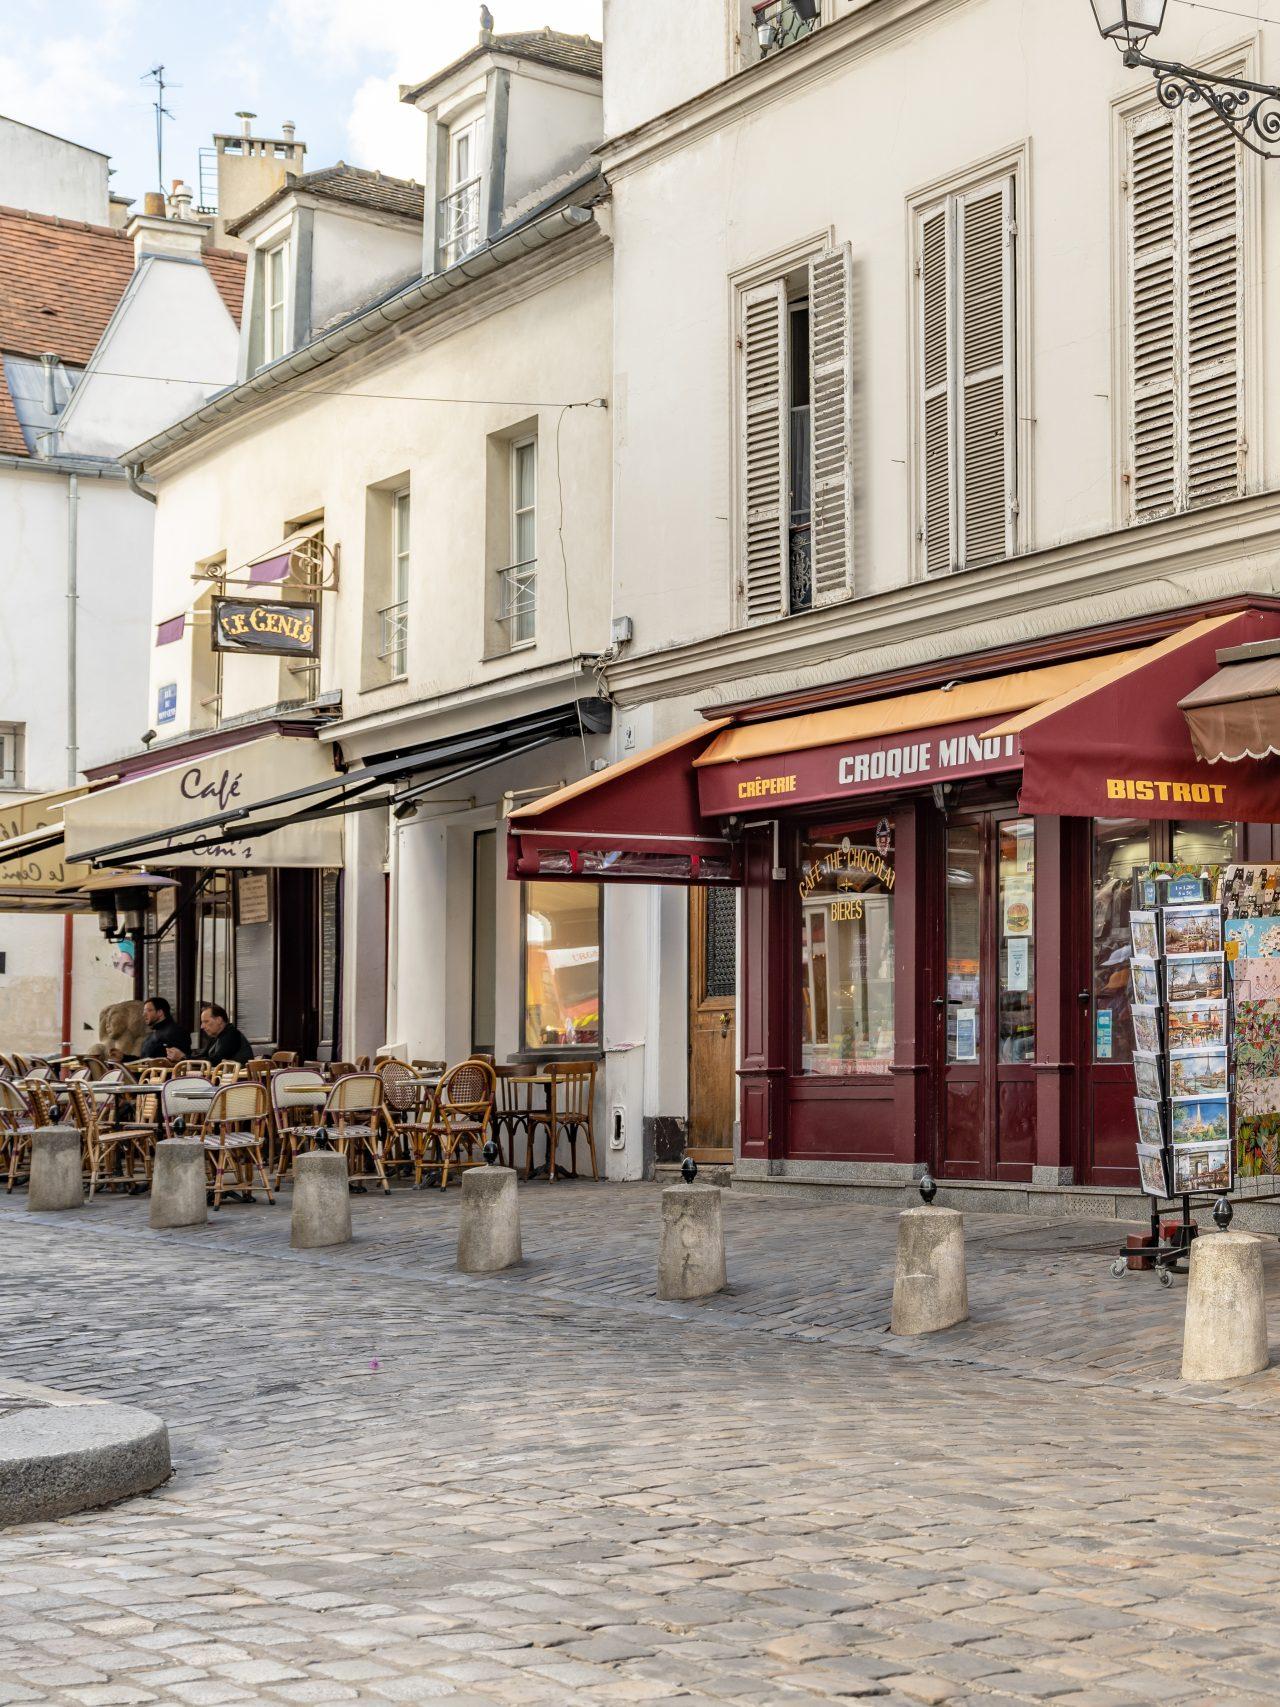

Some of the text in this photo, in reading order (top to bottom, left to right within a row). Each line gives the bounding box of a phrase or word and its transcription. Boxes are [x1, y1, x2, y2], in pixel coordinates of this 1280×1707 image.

[221, 607, 313, 644] LE CENI'S
[838, 742, 931, 785] CROQUE
[180, 768, 243, 810] Café
[738, 775, 797, 799] CRÊPERIE
[1106, 778, 1227, 804] BISTROT
[799, 858, 823, 899] CAFÉ
